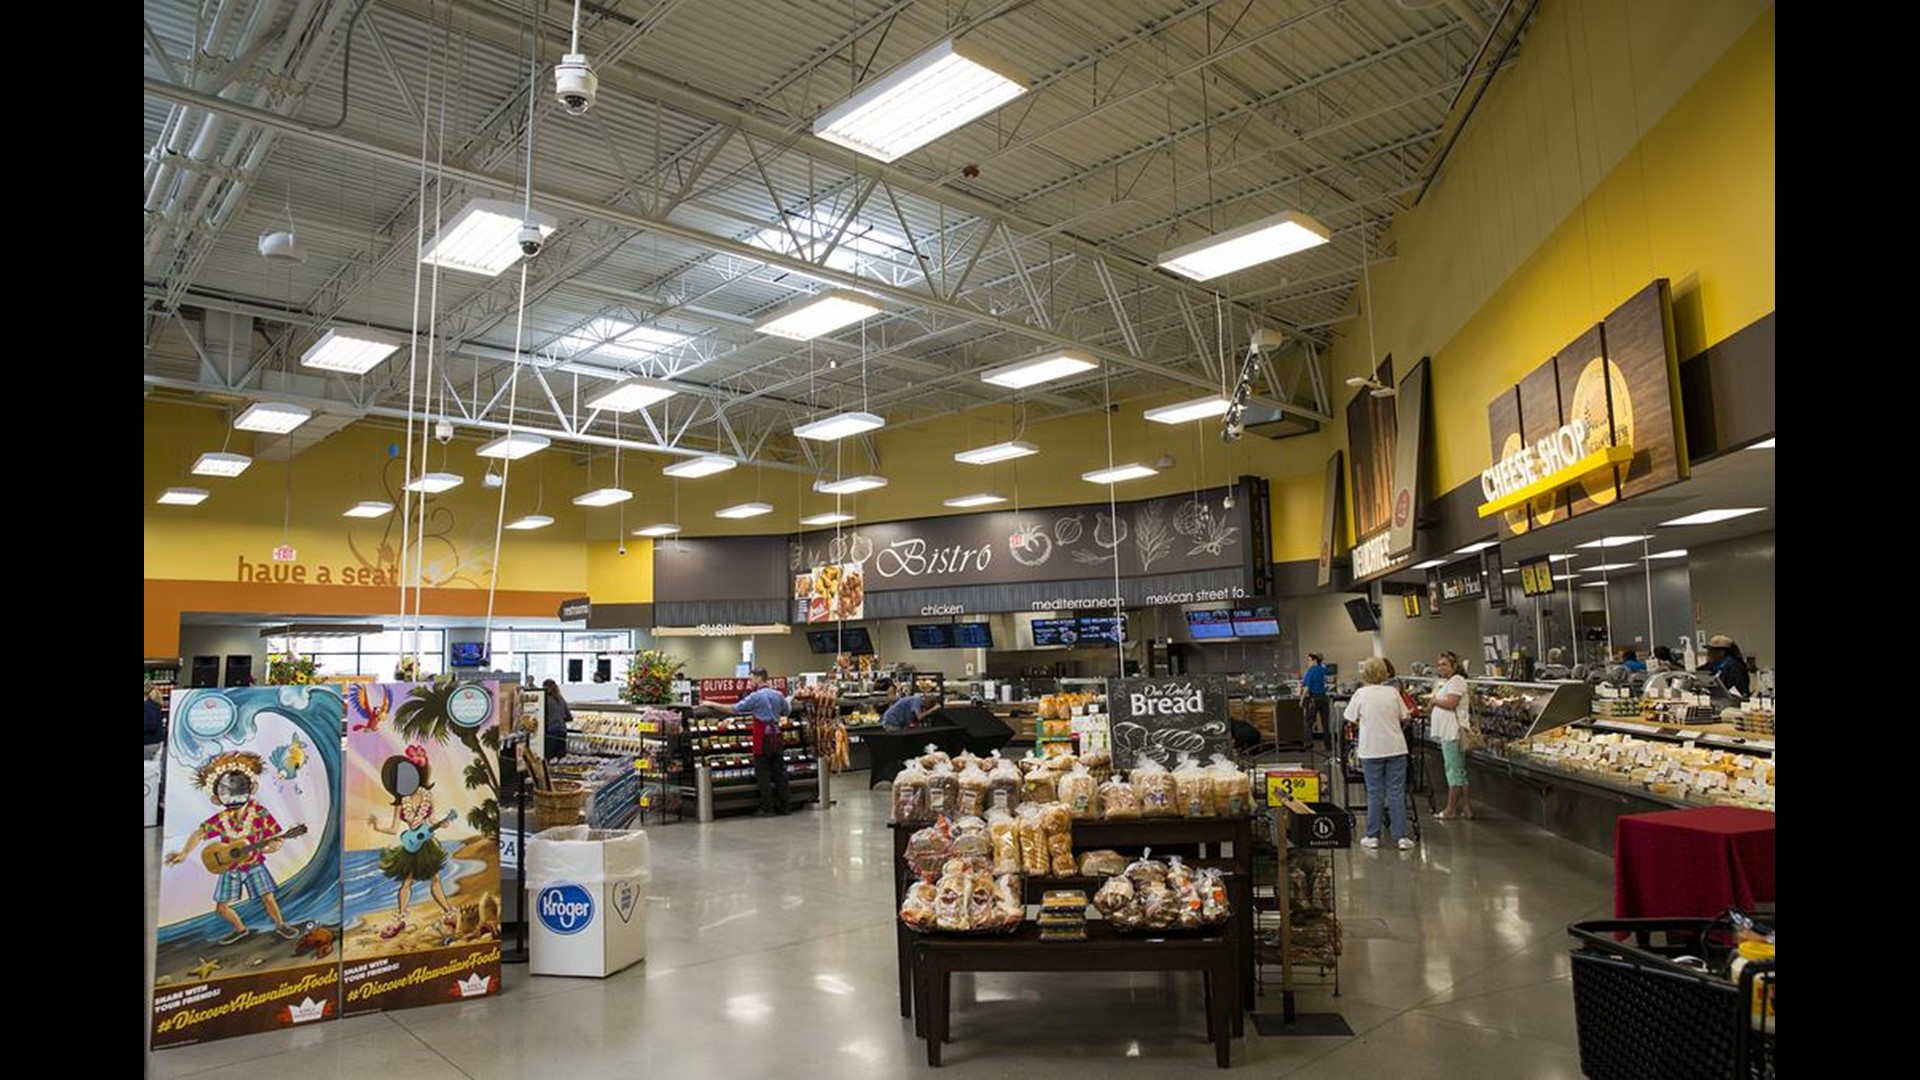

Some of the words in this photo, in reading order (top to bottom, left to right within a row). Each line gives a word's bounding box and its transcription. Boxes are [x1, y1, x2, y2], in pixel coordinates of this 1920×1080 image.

[1481, 447, 1538, 502] CHEESE
[1537, 419, 1587, 475] SHOP
[238, 555, 307, 583] have
[317, 566, 332, 584] a
[342, 565, 399, 587] seat
[1032, 597, 1125, 610] mediterranean
[1146, 592, 1193, 605] mexican
[1196, 587, 1228, 601] street
[921, 604, 964, 616] chicken
[700, 624, 736, 636] SUSHI
[703, 680, 735, 691] OLIVES
[1130, 690, 1204, 716] Bread
[543, 889, 589, 928] Kroger
[347, 947, 501, 1002] #DiscoverHawaiianFoods
[157, 968, 338, 1033] #DiscoverHawaiianFoods
